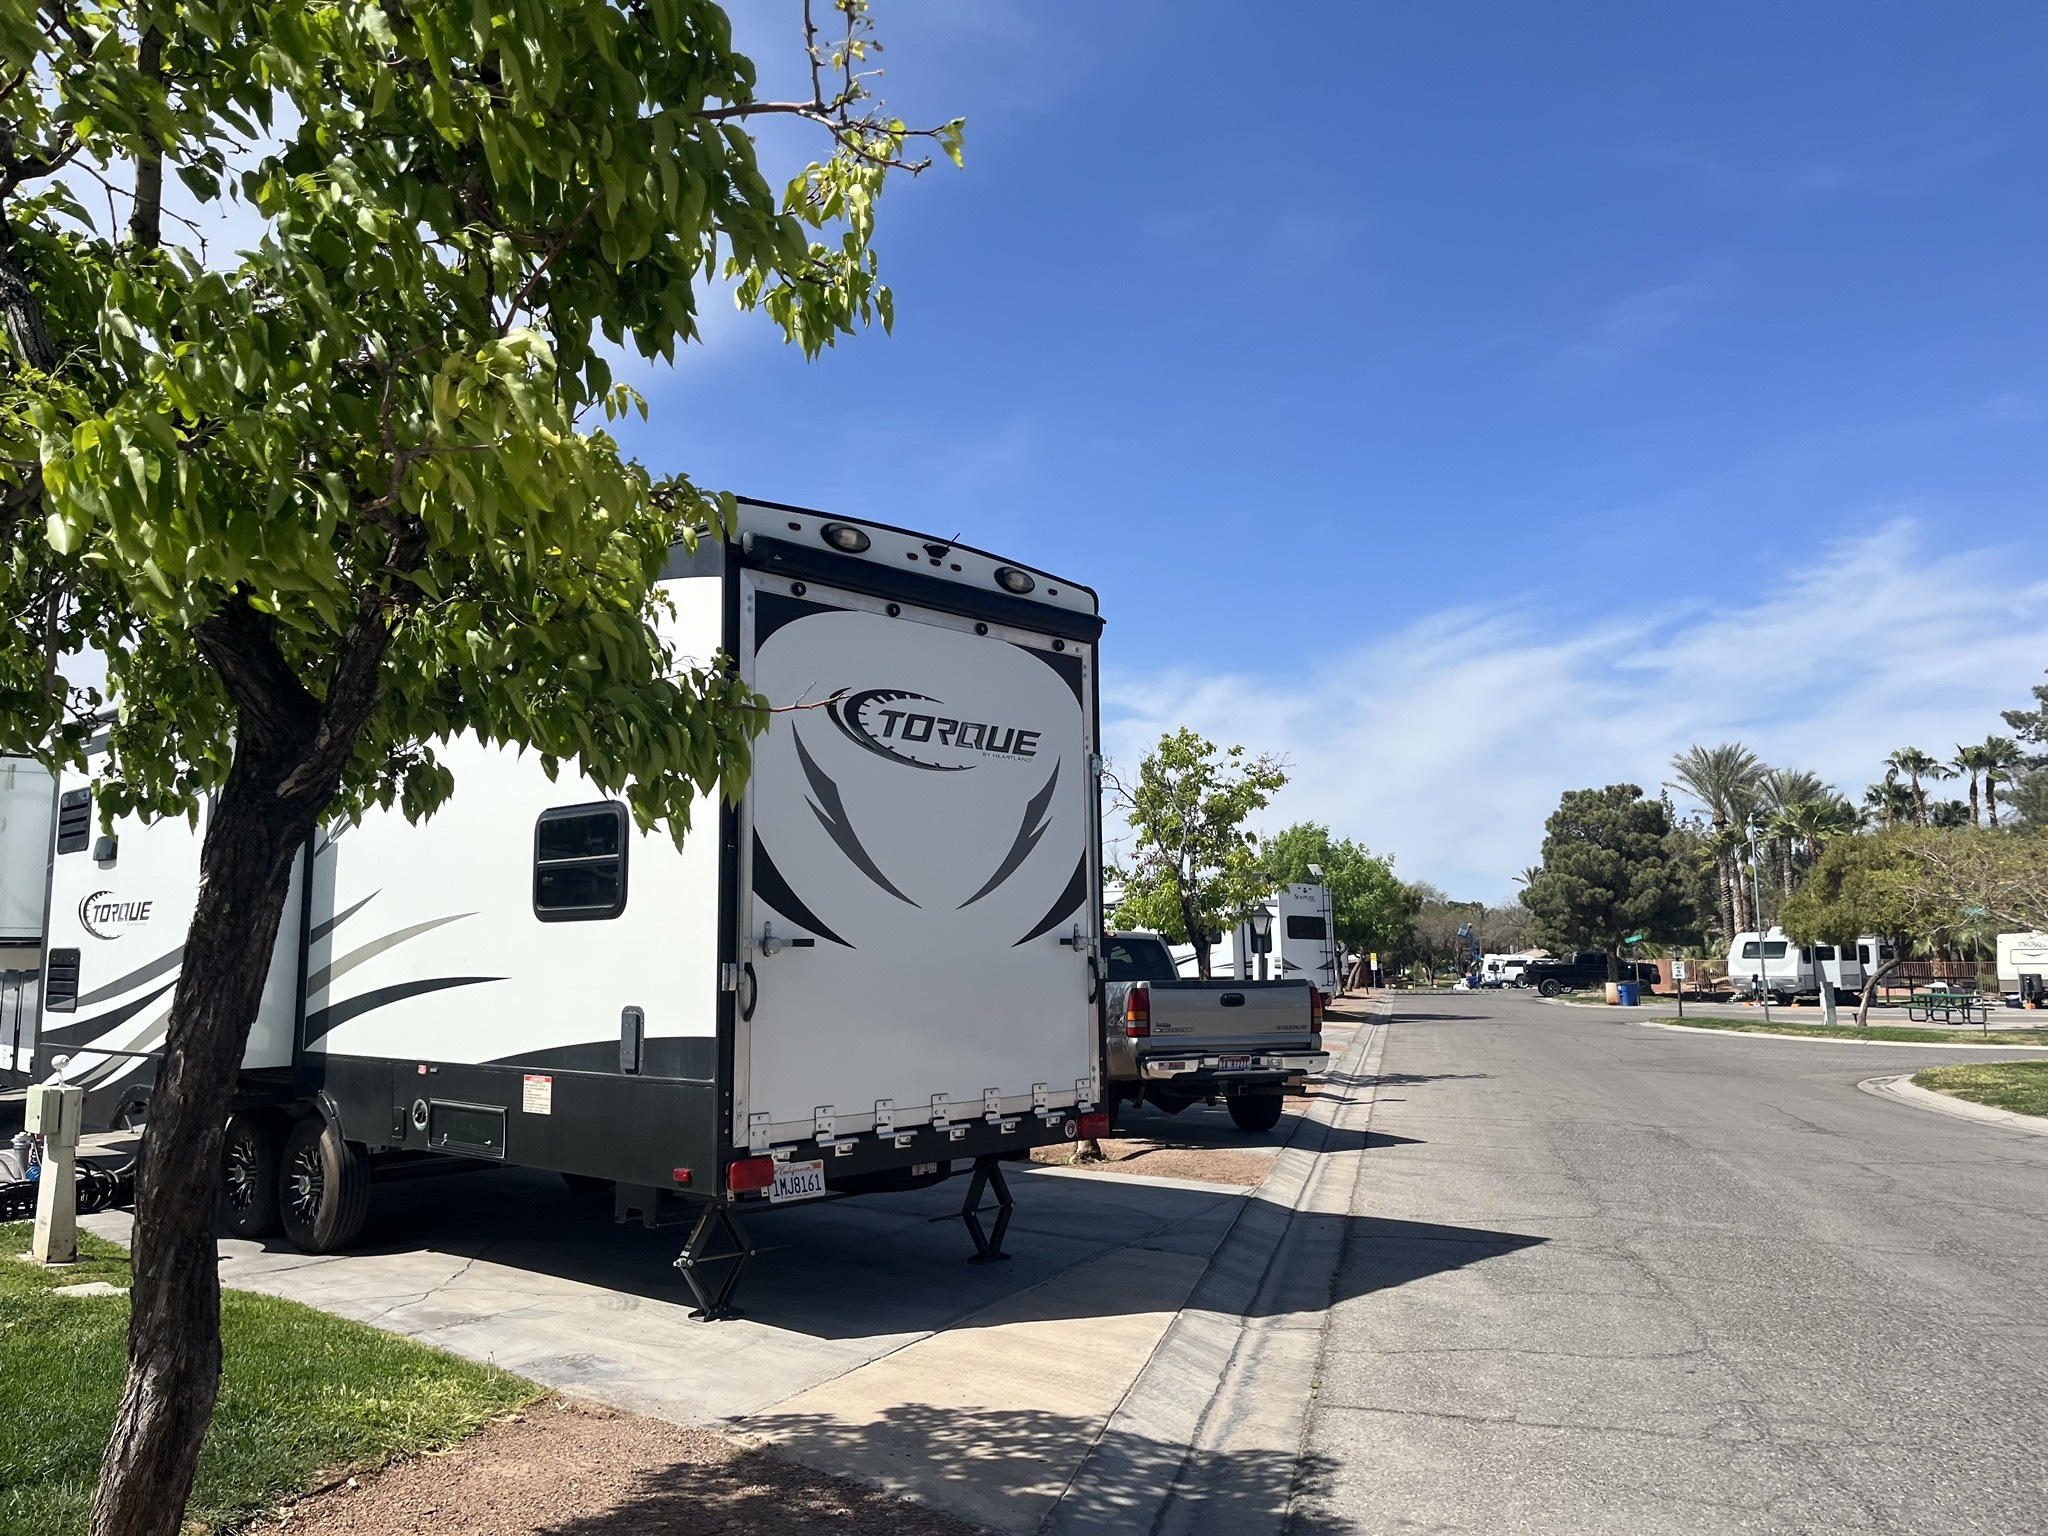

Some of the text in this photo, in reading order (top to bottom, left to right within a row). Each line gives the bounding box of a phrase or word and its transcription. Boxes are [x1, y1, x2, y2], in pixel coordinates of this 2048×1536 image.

[877, 709, 1042, 757] TORQUE
[993, 753, 1032, 763] HEARTLAND
[93, 900, 154, 924] TORQUE
[773, 1174, 822, 1197] 1MJ8161
